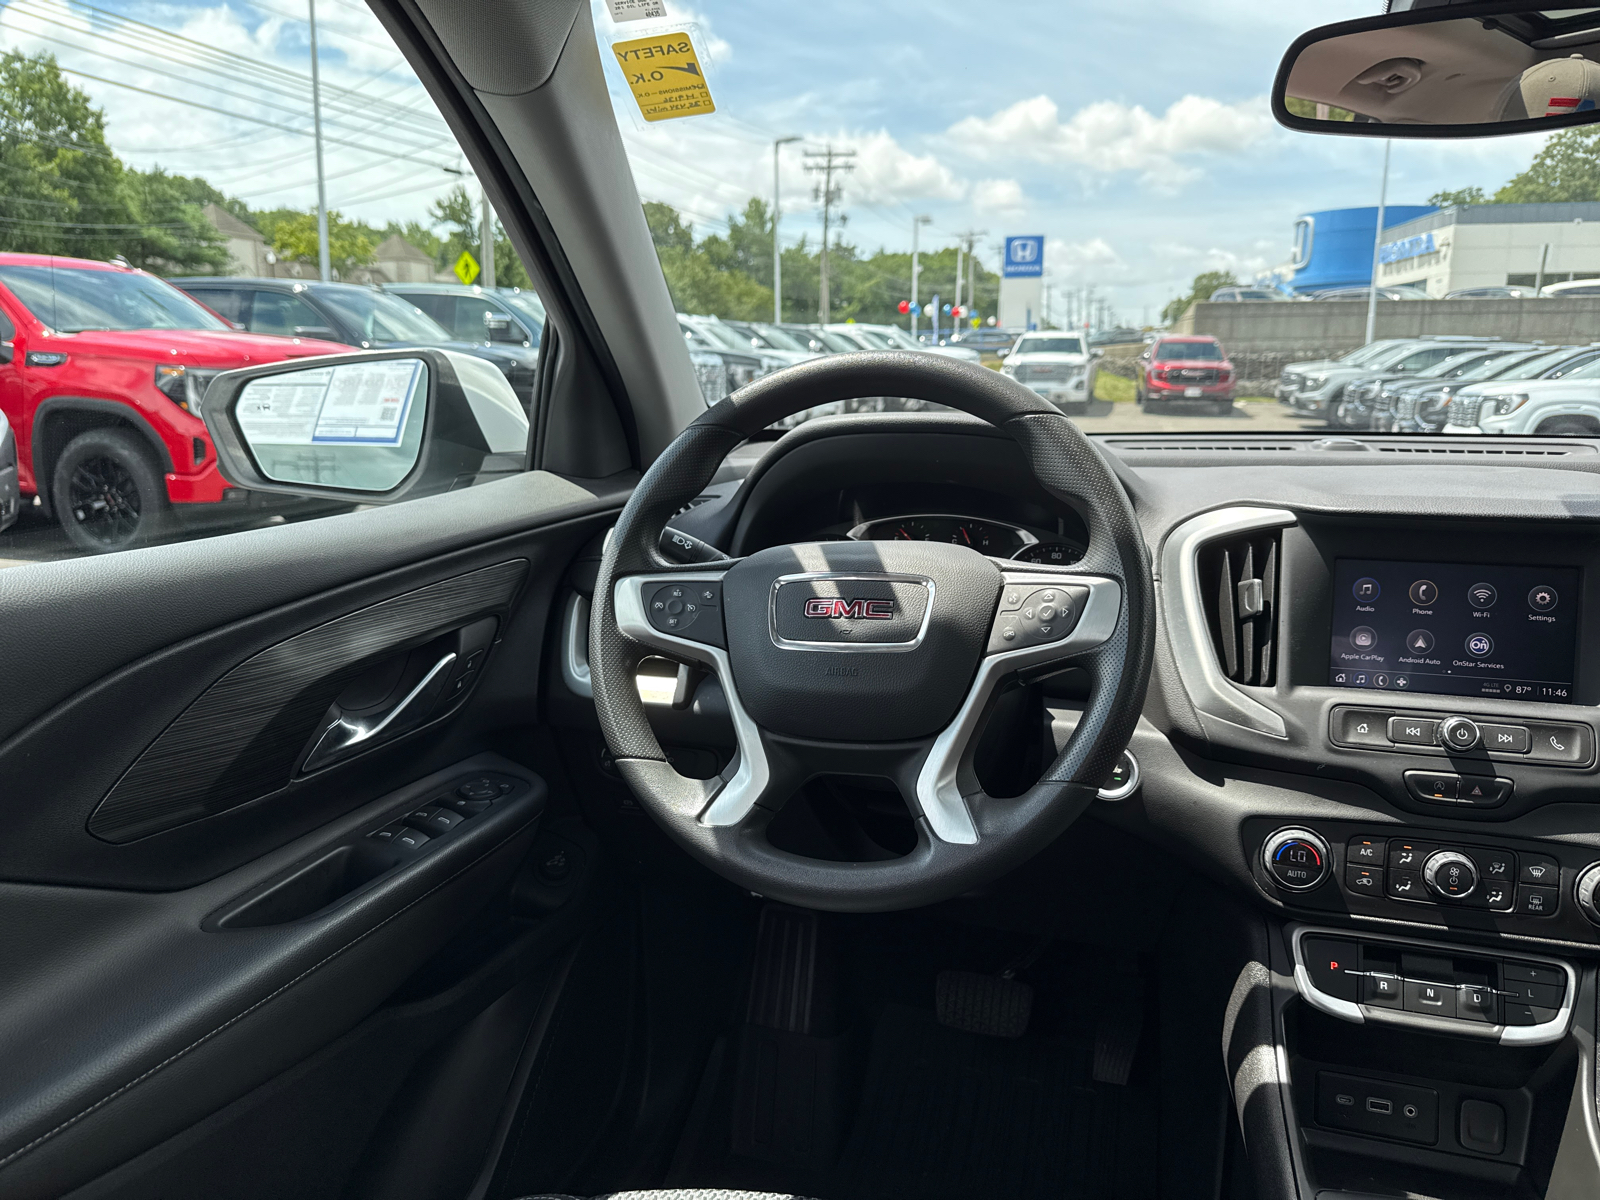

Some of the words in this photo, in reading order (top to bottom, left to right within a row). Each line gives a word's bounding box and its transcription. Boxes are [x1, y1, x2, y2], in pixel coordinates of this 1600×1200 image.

[804, 598, 894, 619] GMC
[1528, 614, 1556, 623] Settings
[1341, 653, 1359, 661] Apple
[1360, 653, 1385, 663] CarPlay
[1398, 656, 1424, 664] Android
[1477, 661, 1504, 669] Services
[1515, 685, 1532, 694] 87°
[1542, 687, 1568, 697] 11:46
[1360, 848, 1373, 856] A/C
[1287, 869, 1307, 878] AUTO
[1330, 961, 1339, 970] P
[1379, 981, 1388, 990] R
[1426, 988, 1434, 997] N
[1528, 989, 1535, 998] L
[1473, 993, 1482, 1002] D
